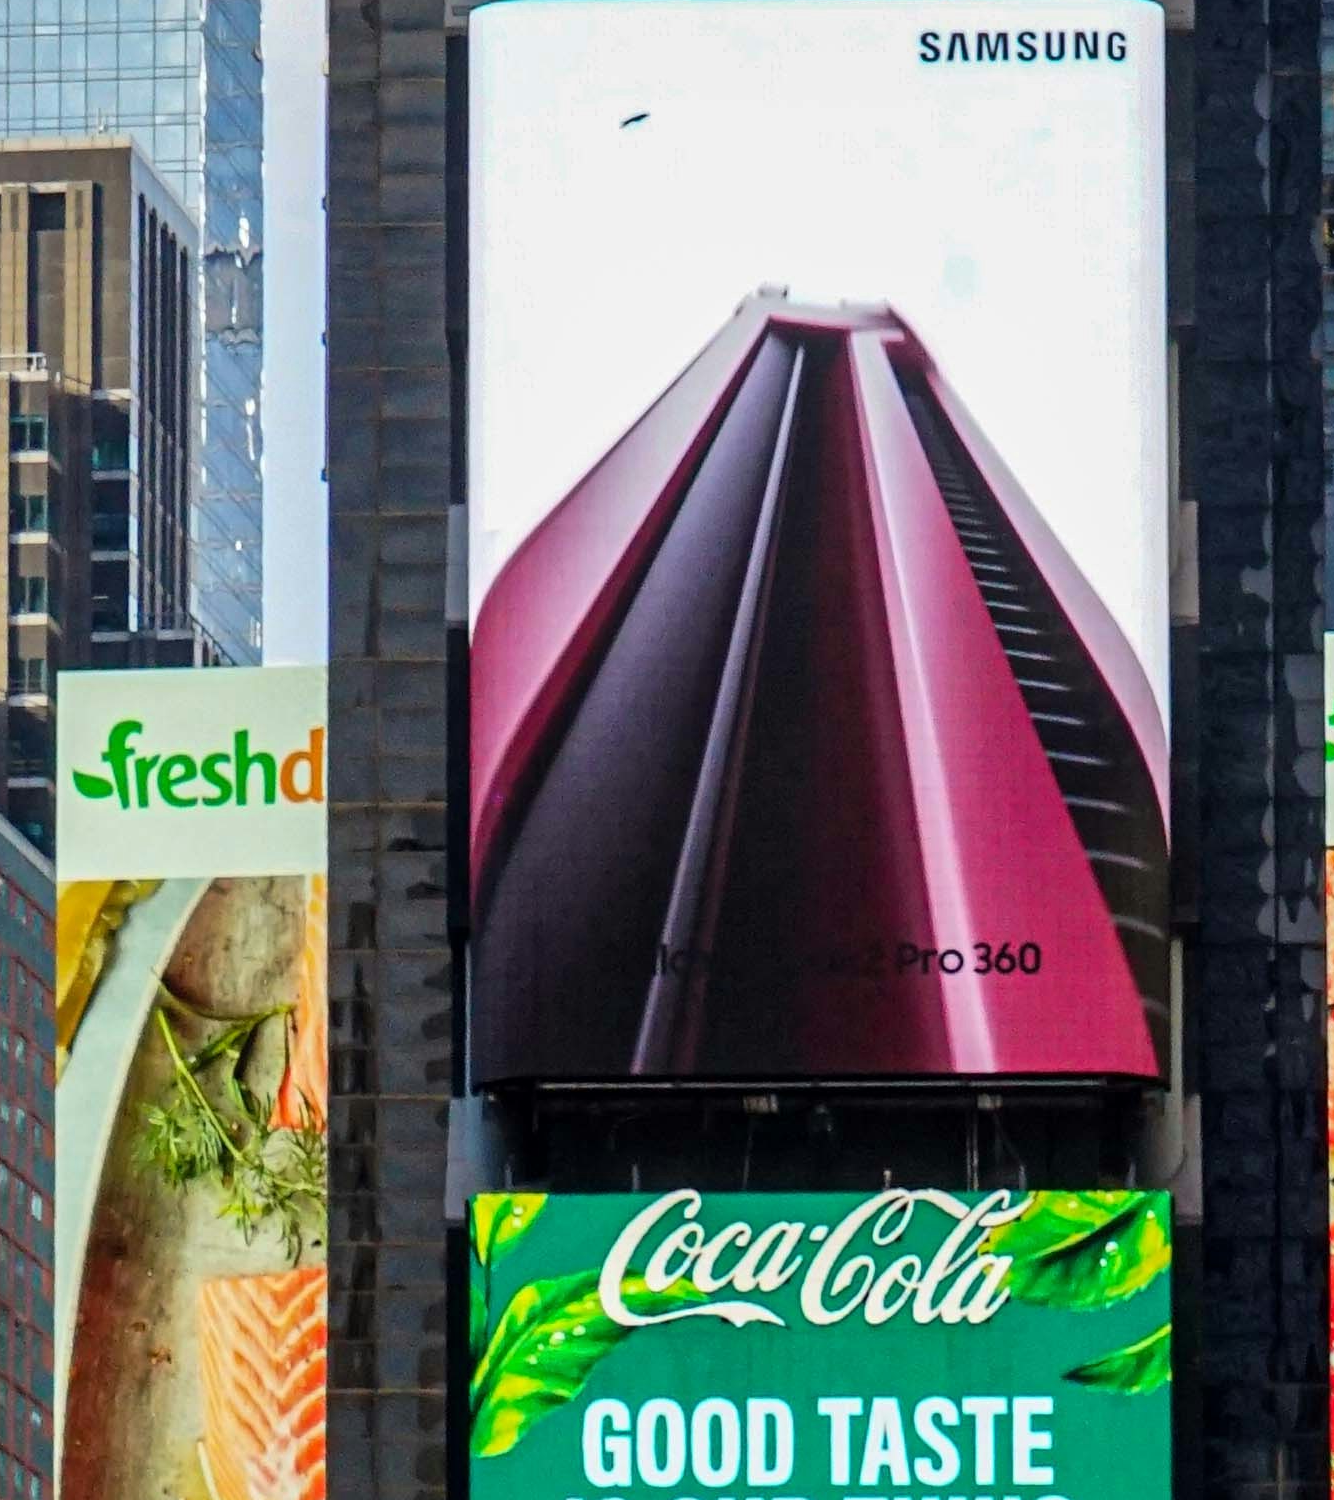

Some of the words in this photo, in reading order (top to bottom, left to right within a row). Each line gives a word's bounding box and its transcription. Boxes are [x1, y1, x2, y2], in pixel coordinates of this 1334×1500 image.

[920, 31, 1127, 63] SAMSUNG
[897, 942, 964, 976] Pro
[974, 942, 1042, 976] 360
[598, 1188, 1038, 1328] Coca-Cola
[582, 1397, 794, 1488] GOOD
[818, 1396, 1055, 1486] TASTE
